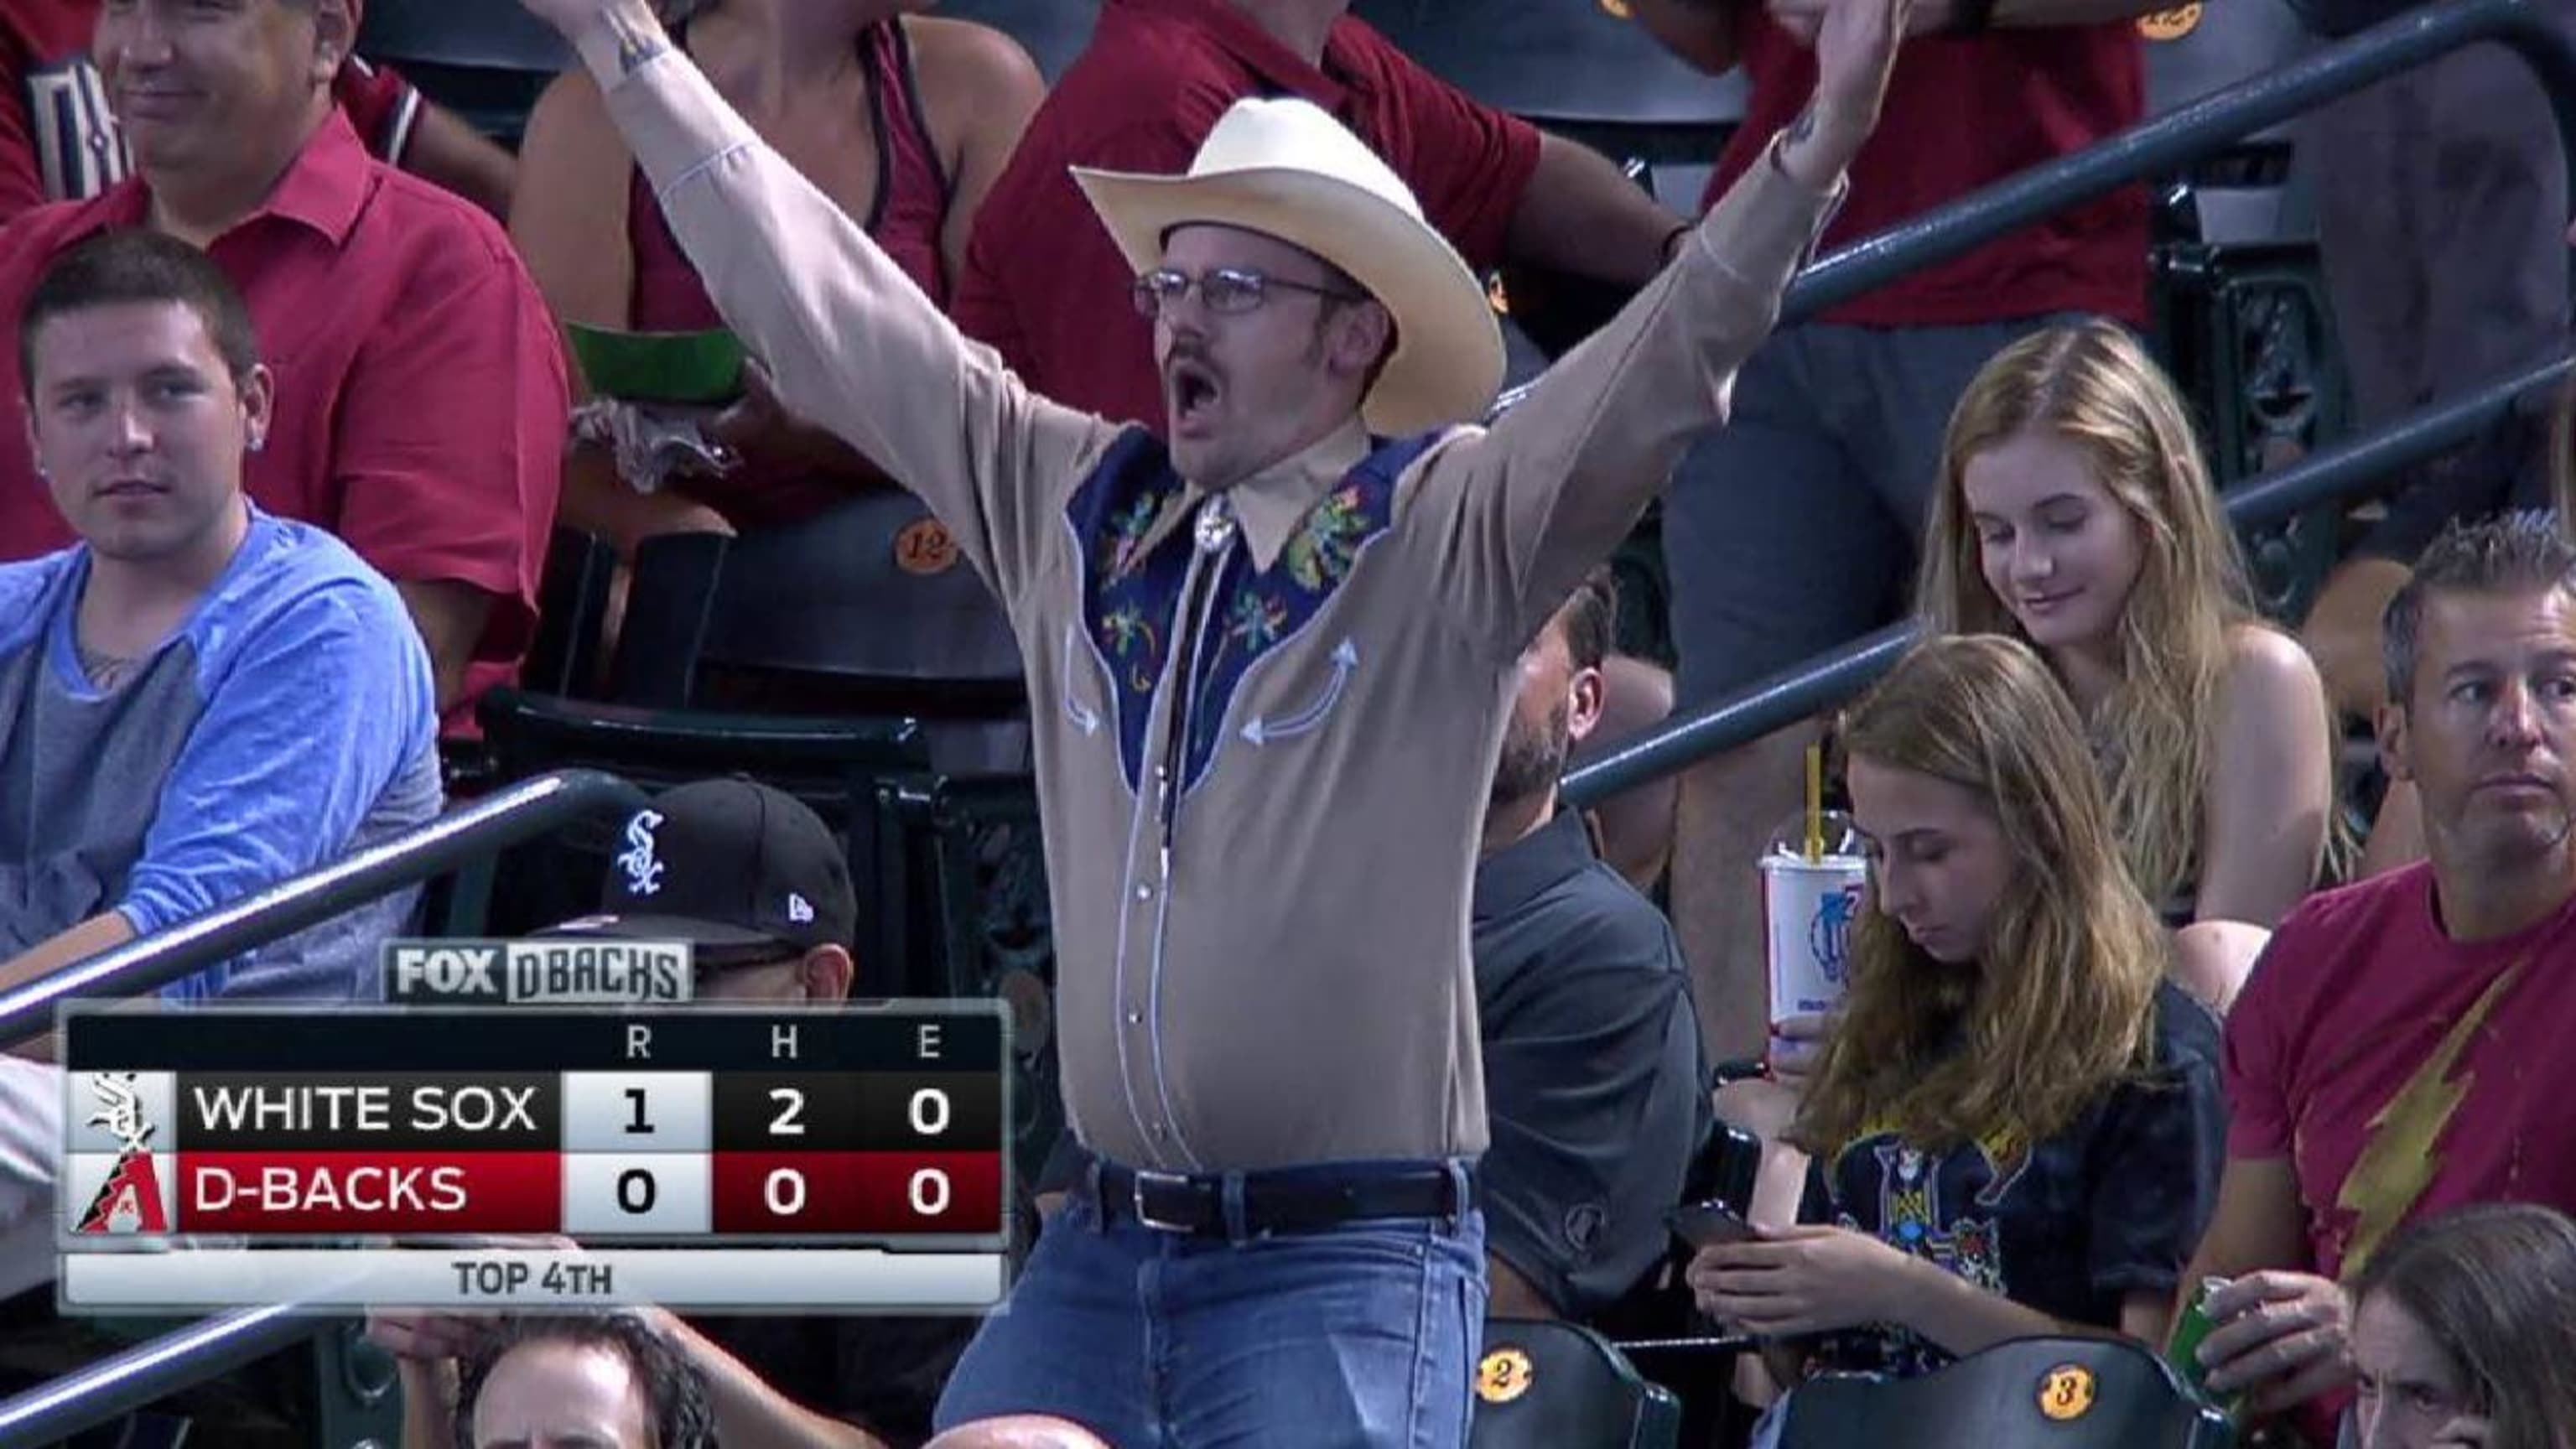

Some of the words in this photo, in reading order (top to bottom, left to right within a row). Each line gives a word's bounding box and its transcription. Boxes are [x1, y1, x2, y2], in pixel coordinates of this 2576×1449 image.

[906, 528, 954, 560] 12
[1490, 1358, 1513, 1388] 2
[2056, 1376, 2077, 1406] 3
